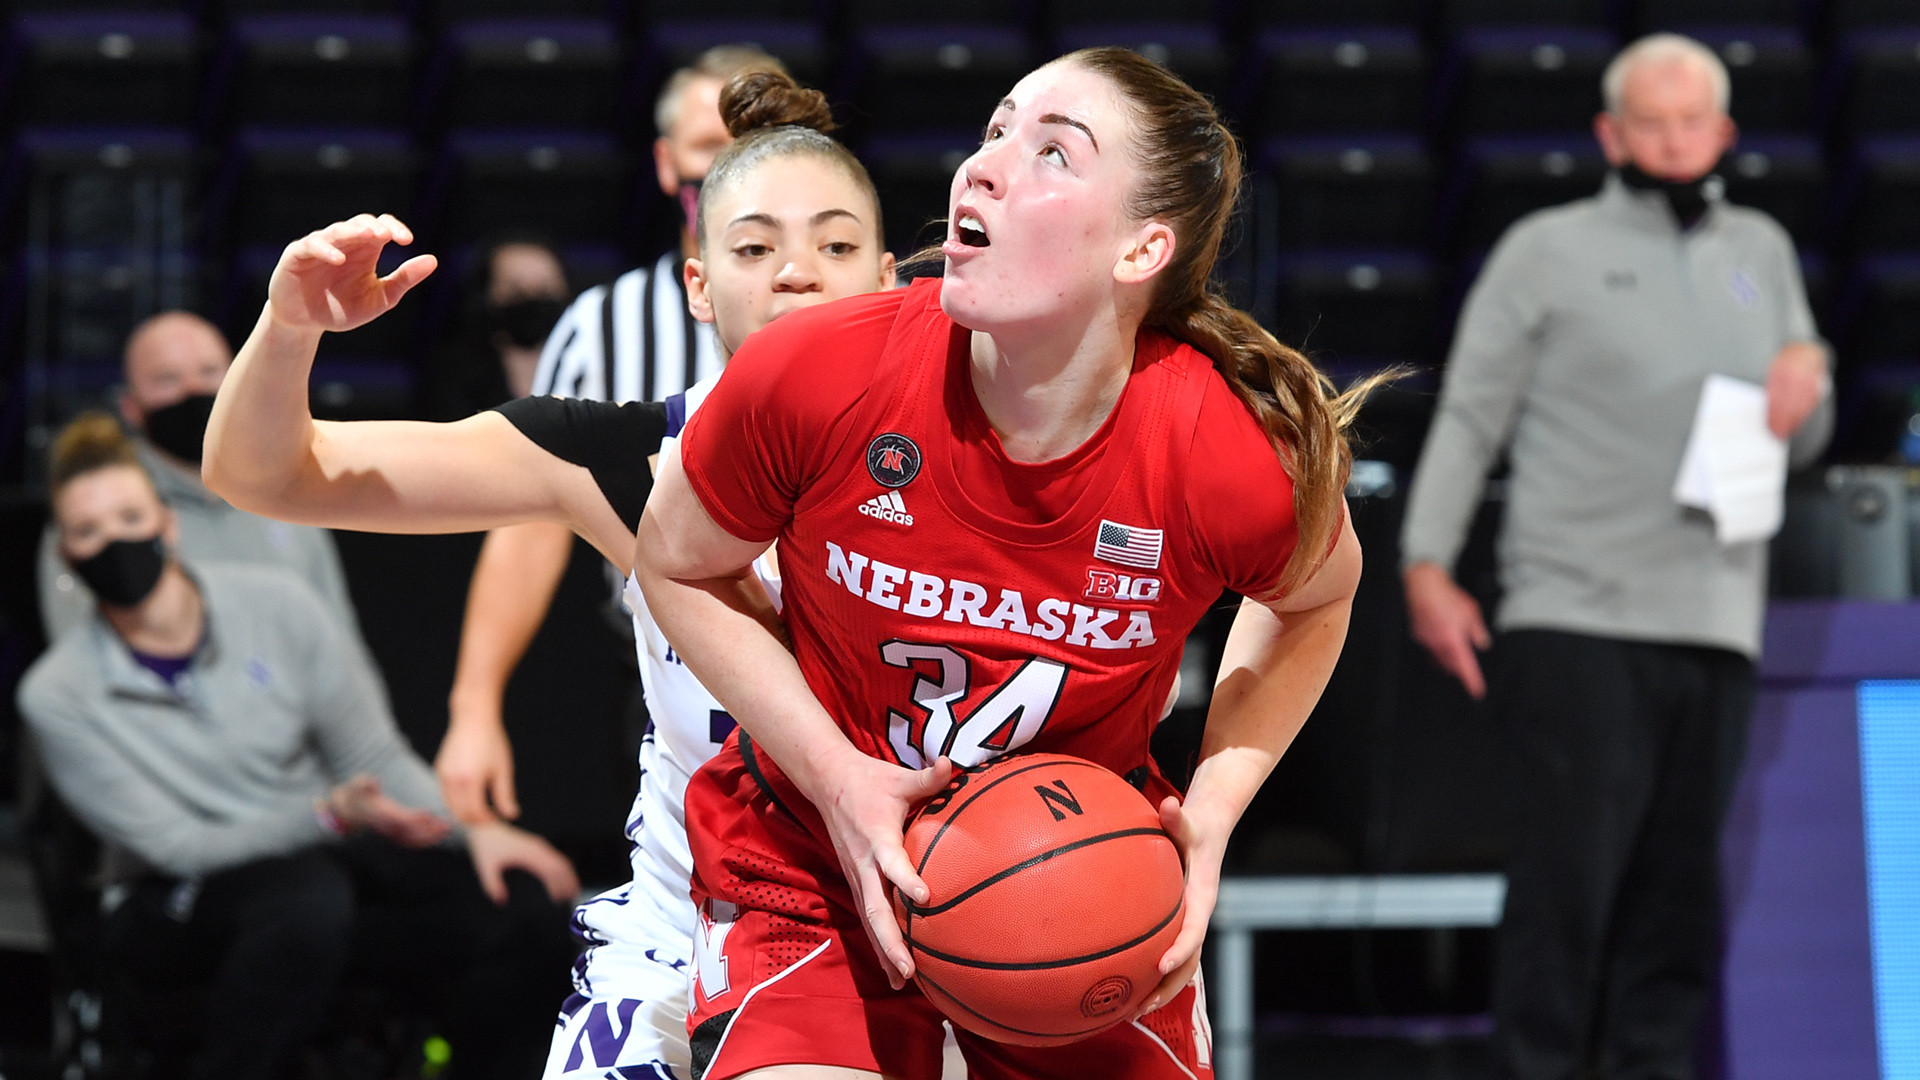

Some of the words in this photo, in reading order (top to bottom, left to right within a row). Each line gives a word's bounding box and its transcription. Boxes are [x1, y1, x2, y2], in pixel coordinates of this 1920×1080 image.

[881, 449, 904, 472] N
[858, 503, 914, 527] adidas
[825, 540, 1158, 650] NEBRASKA
[878, 637, 1071, 771] 34
[1033, 779, 1085, 823] N
[562, 998, 645, 1075] N
